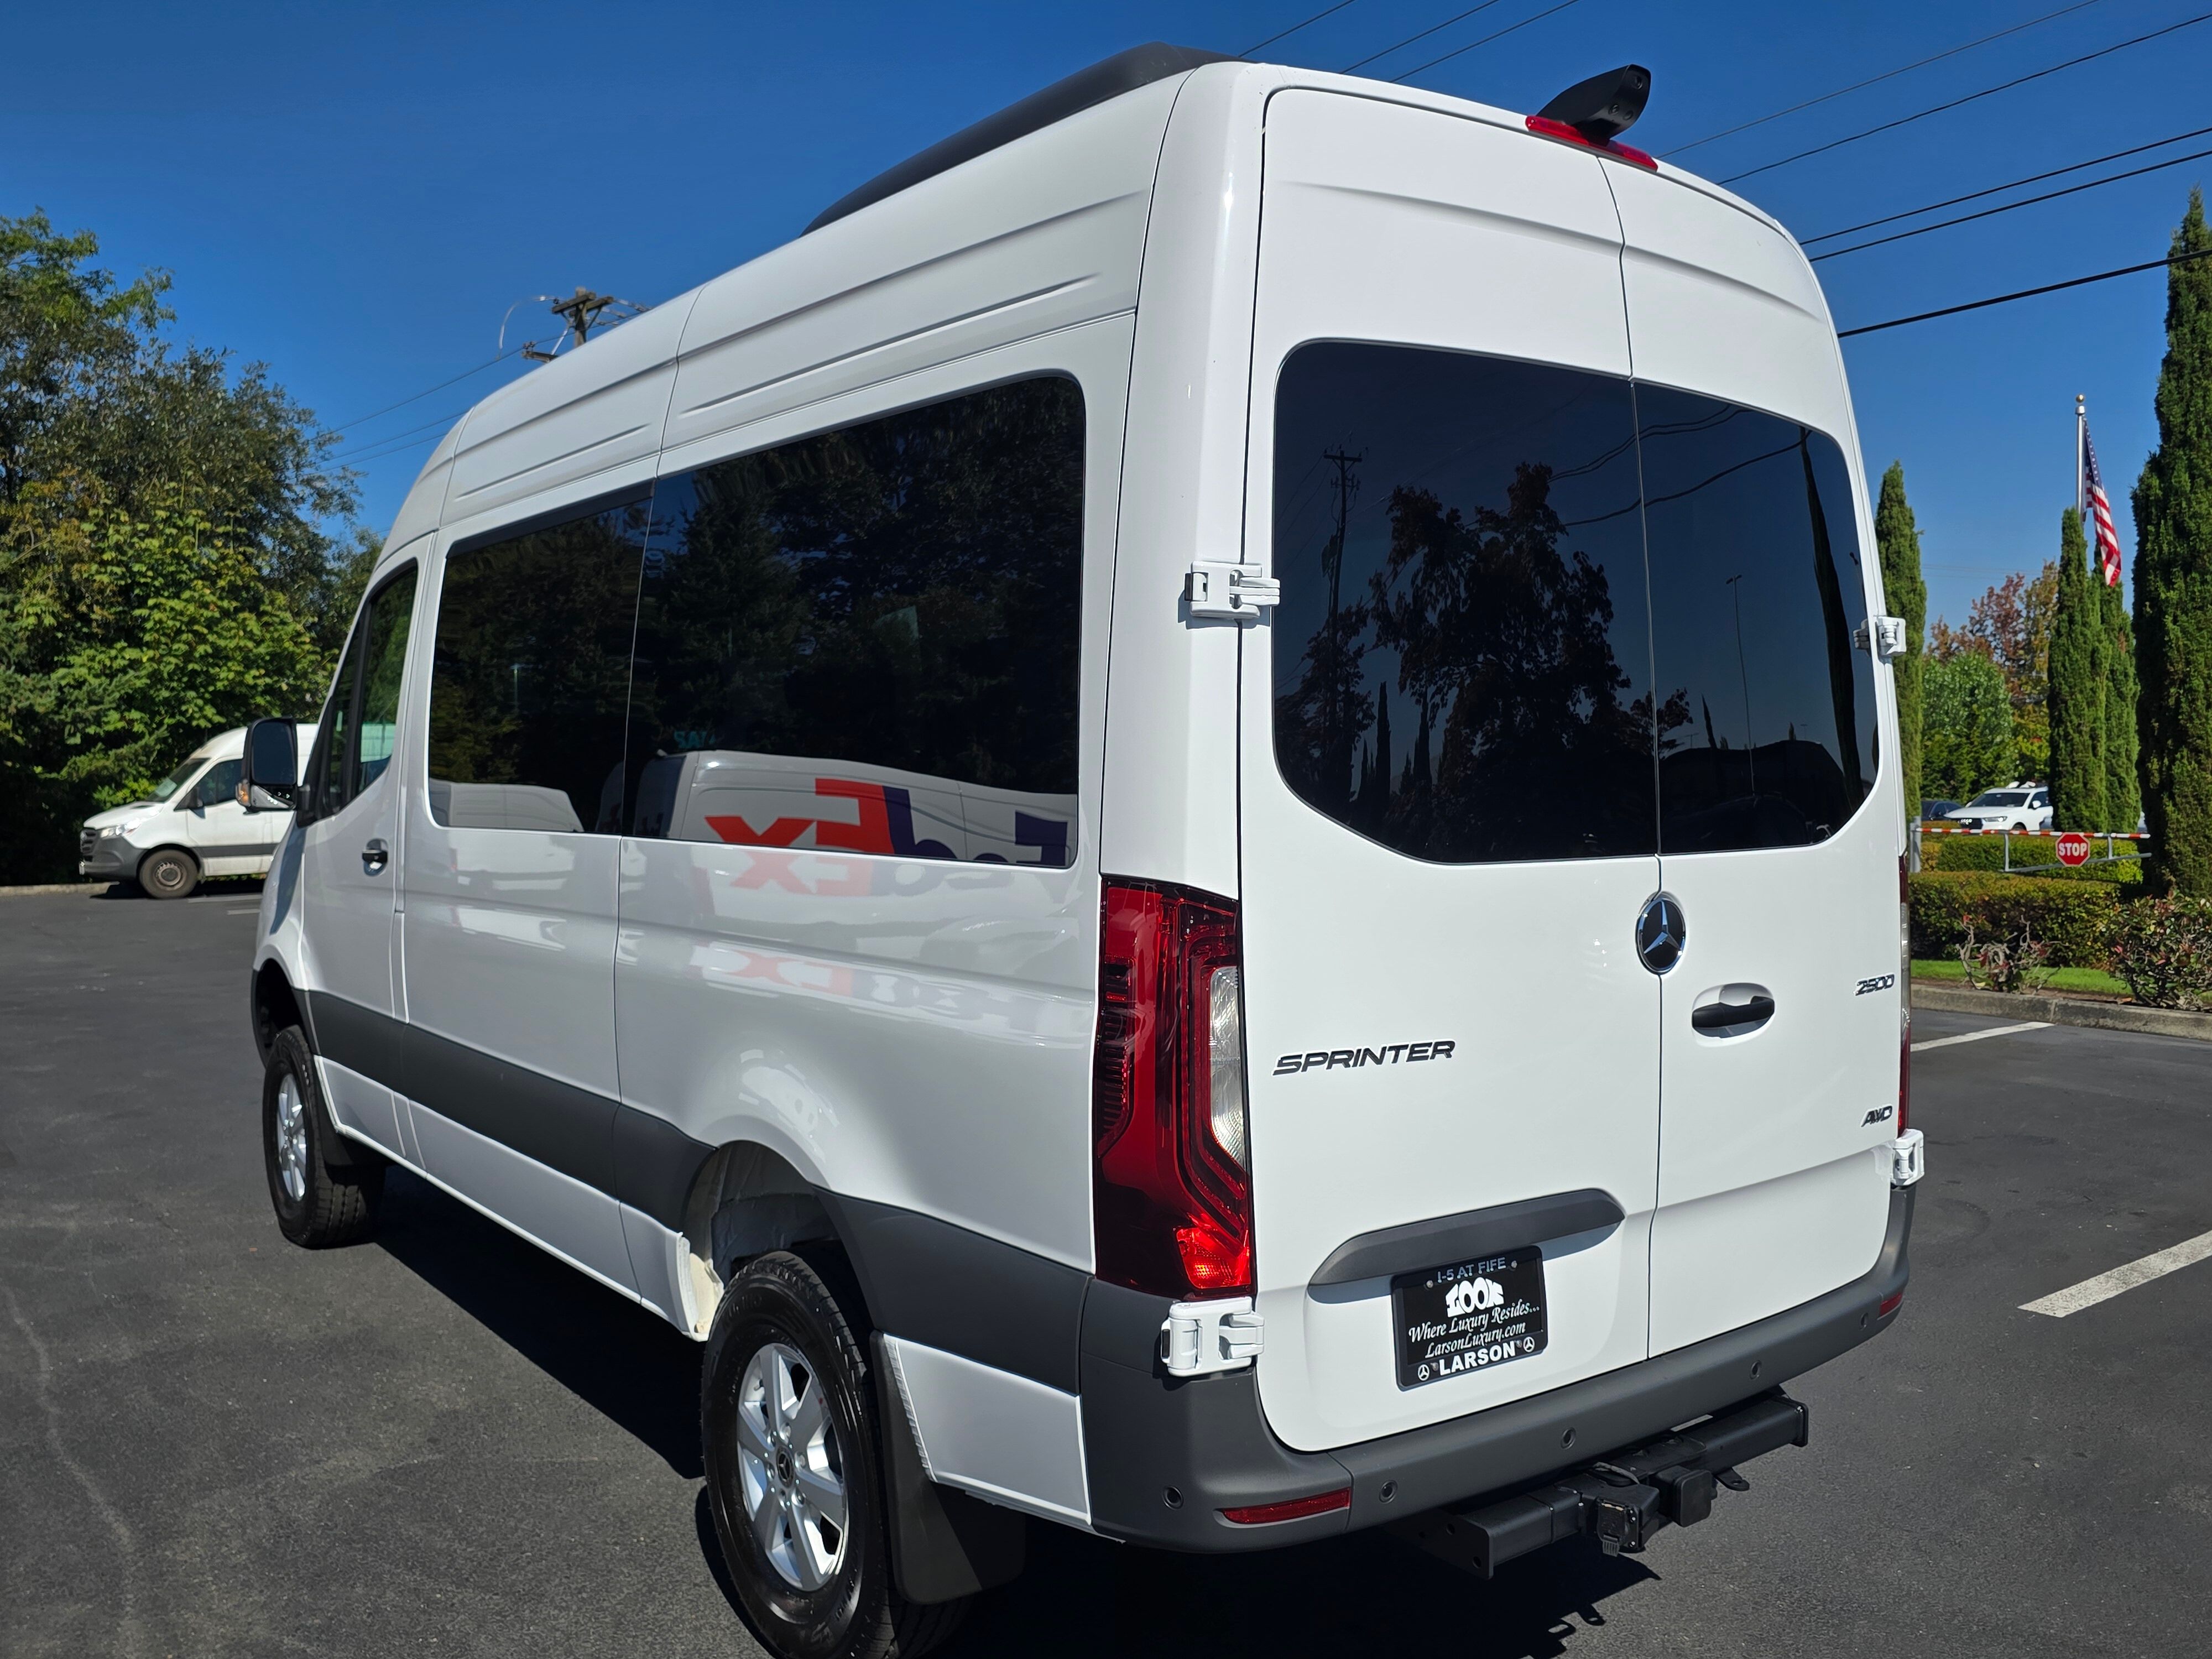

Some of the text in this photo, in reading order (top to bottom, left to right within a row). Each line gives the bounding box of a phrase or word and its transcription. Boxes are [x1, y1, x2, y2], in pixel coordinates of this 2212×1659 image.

[2058, 842, 2088, 857] STOP
[1855, 973, 1895, 996] 2500
[1272, 1040, 1455, 1076] SPRINTER
[1860, 1105, 1893, 1128] AWD
[1437, 1257, 1506, 1284] I-5 AT FIFE
[1408, 1298, 1540, 1343] Where Luxury Resides...
[1425, 1322, 1526, 1359] LarsonLuxury.com
[1439, 1340, 1516, 1376] LARSON
